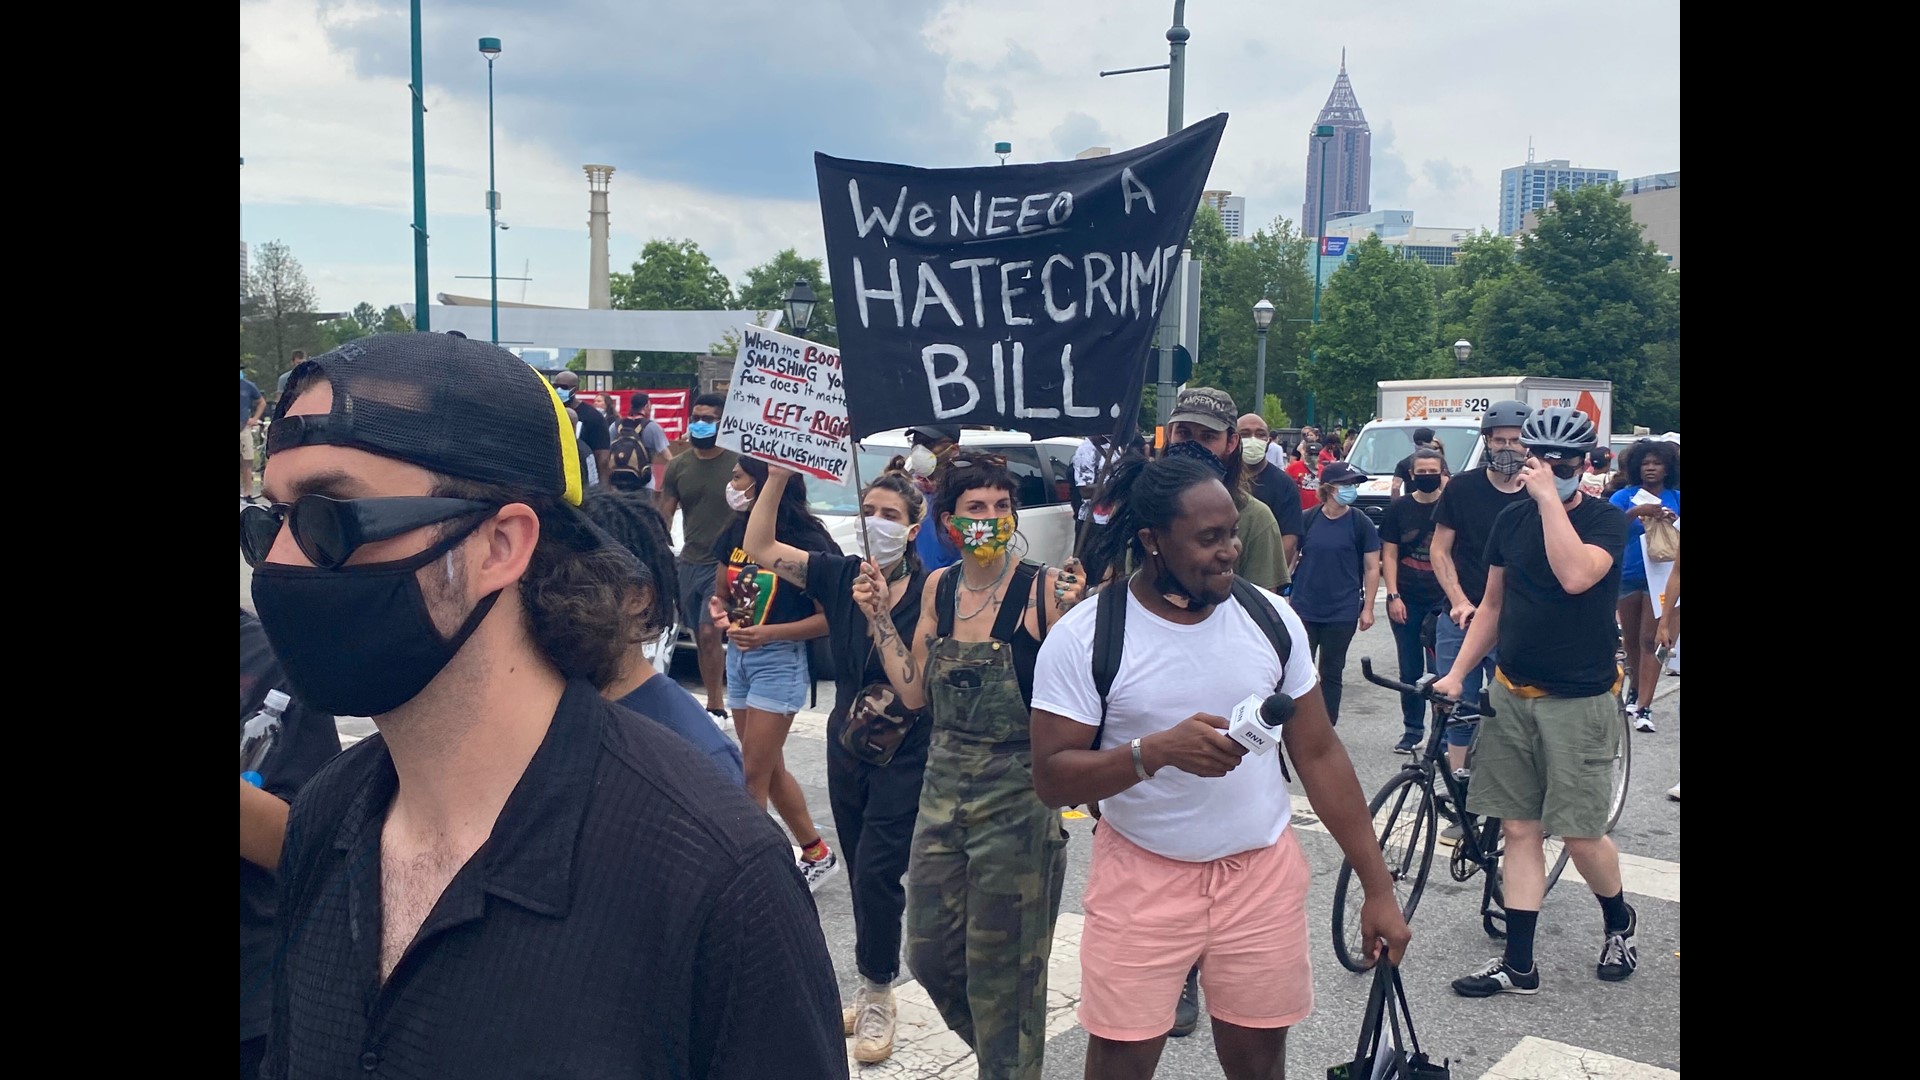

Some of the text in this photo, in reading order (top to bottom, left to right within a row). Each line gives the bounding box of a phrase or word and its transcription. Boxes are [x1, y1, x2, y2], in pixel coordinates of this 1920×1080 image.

[849, 167, 1156, 238] We NEED A
[744, 330, 779, 354] When
[781, 345, 800, 358] the
[740, 369, 766, 386] face
[770, 378, 799, 394] does
[804, 382, 814, 396] it
[744, 350, 845, 390] SMASHING Yo
[922, 341, 1121, 420] BILL.
[746, 394, 760, 406] the
[762, 397, 806, 424] LEFT
[1428, 399, 1448, 407] RENT
[1464, 398, 1489, 412] $29
[739, 419, 767, 436] LIVES
[769, 428, 812, 444] MATTER
[816, 439, 848, 452] UNTIL
[741, 434, 848, 477] BLACK LIVES MATTER!
[1245, 731, 1265, 745] BNN
